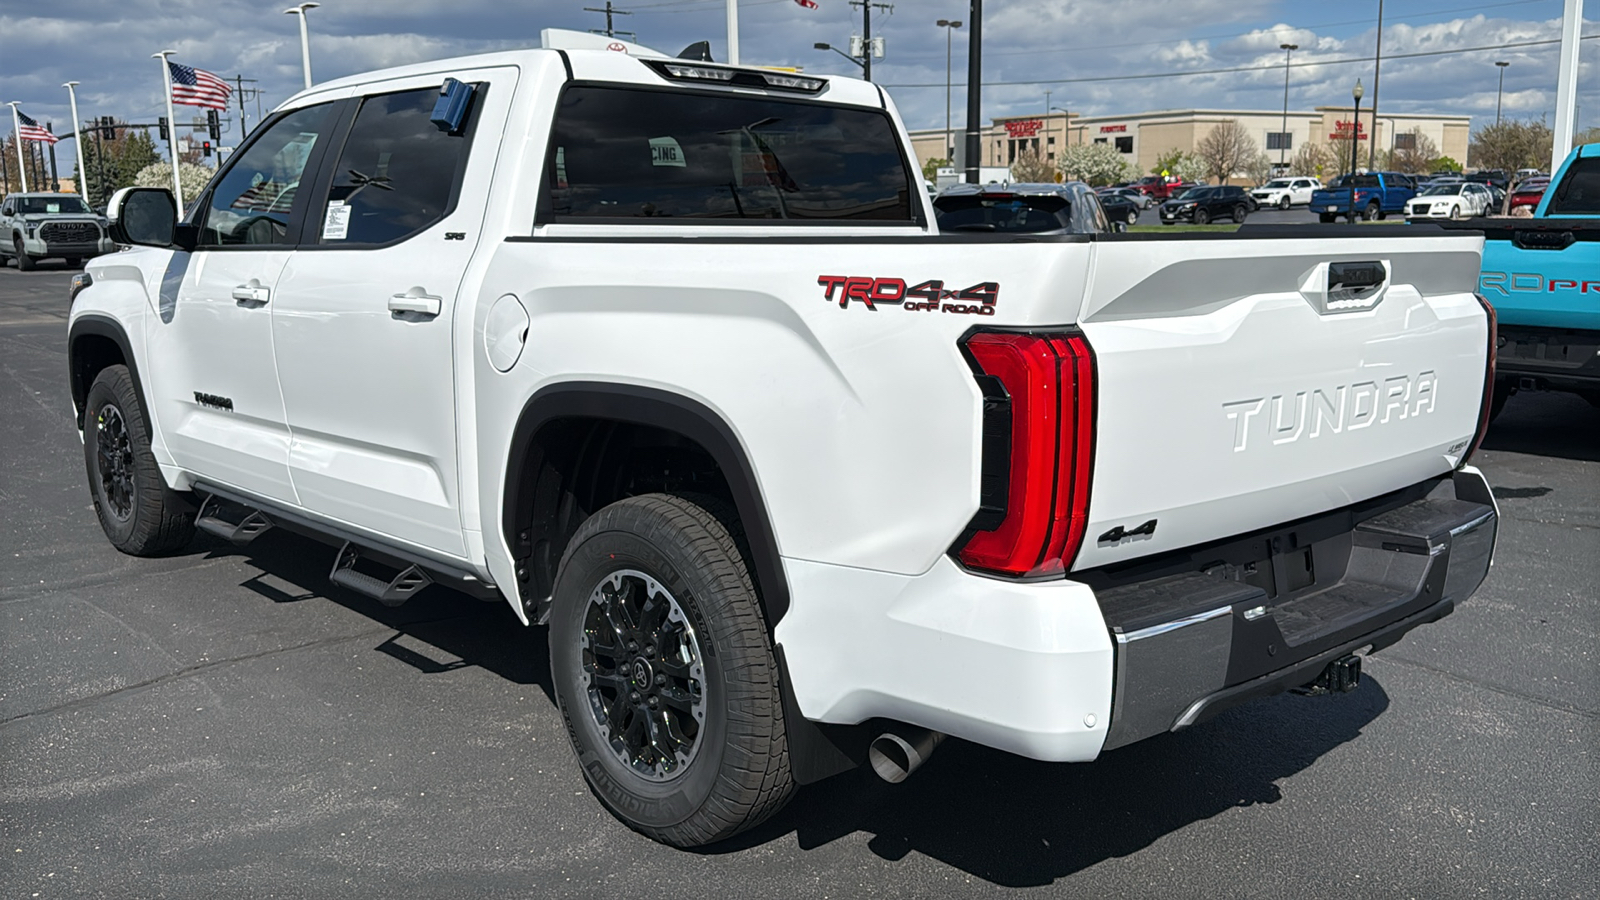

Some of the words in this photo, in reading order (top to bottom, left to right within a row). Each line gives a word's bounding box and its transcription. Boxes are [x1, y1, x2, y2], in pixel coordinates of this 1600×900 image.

[444, 232, 466, 240] SR5
[818, 275, 907, 311] TRD
[904, 302, 939, 312] OFF
[942, 304, 995, 316] ROAD
[194, 391, 234, 411] TUNDRA
[1222, 370, 1437, 453] TUNDRA
[590, 764, 660, 817] MICHELIN
